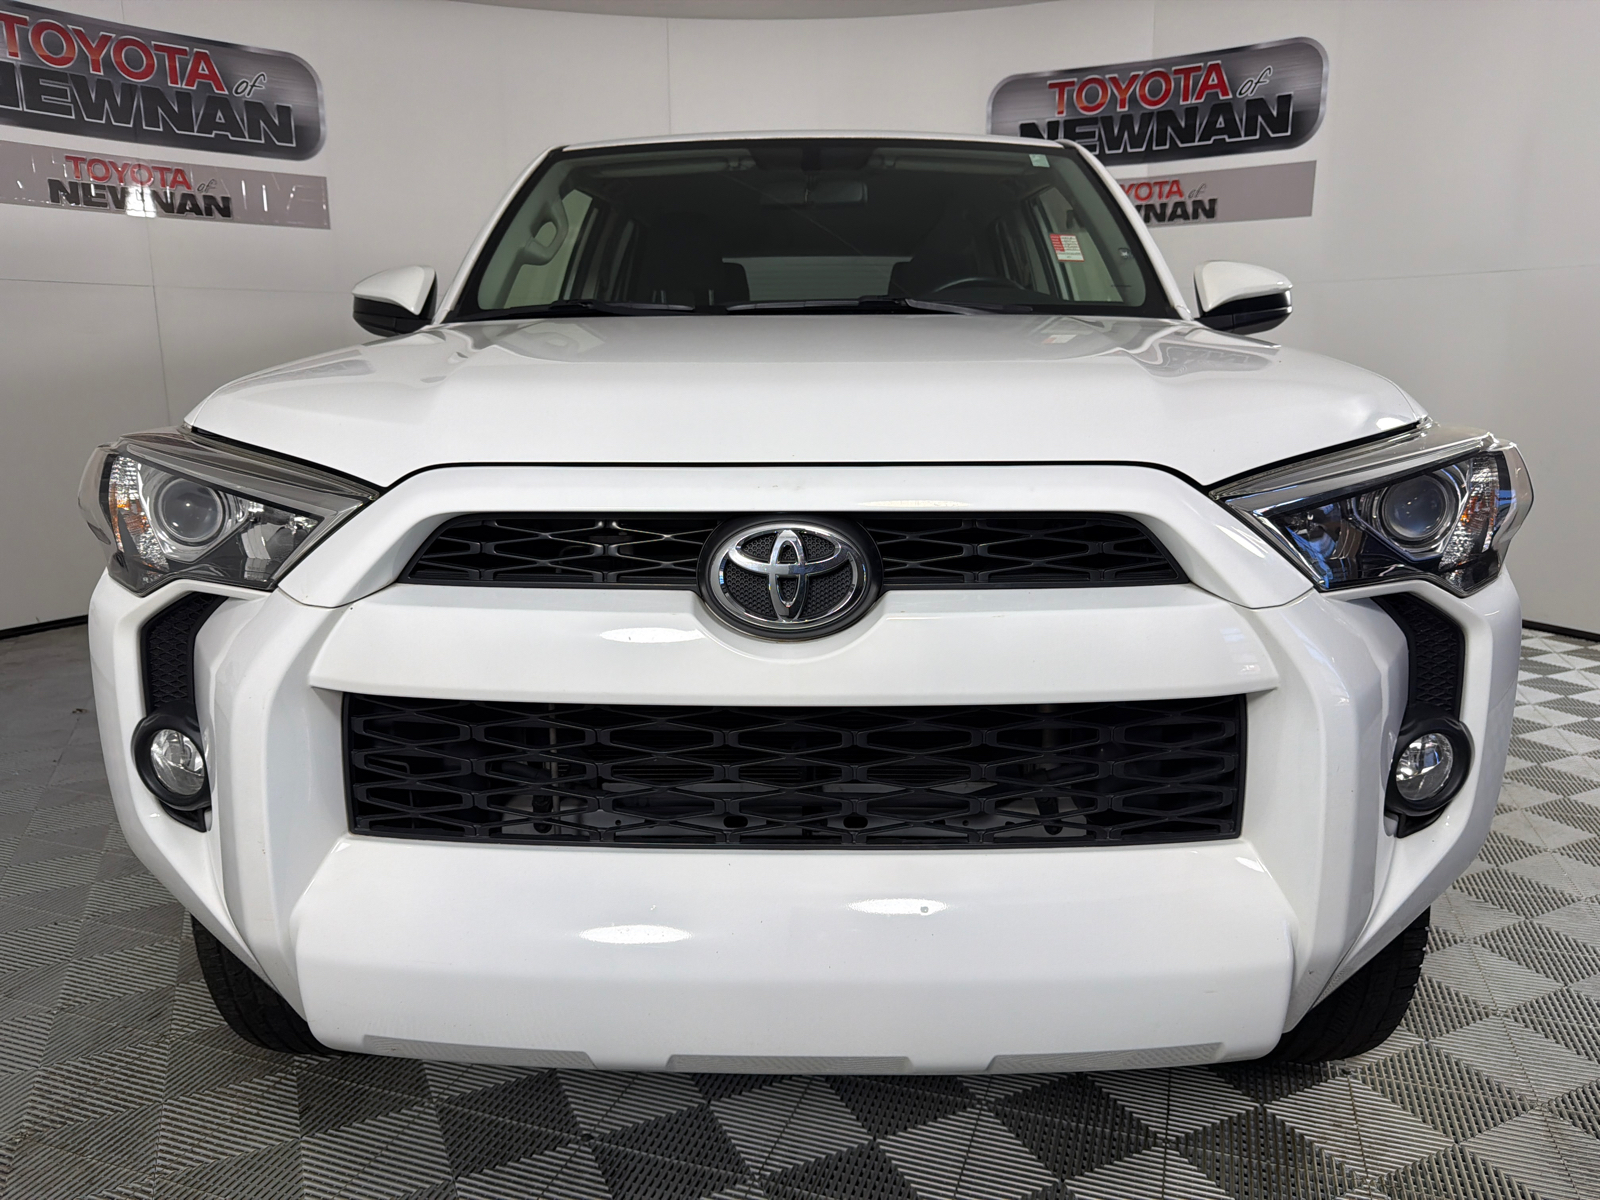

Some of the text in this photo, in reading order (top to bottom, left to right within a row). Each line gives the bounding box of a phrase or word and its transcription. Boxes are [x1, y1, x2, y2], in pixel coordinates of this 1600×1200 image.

[0, 10, 266, 97] TOYOTA of
[1047, 61, 1273, 116] TOYOTA of
[65, 155, 217, 193] TOYOTA of
[1120, 179, 1207, 202] YOTA of
[1135, 198, 1218, 223] NAN
